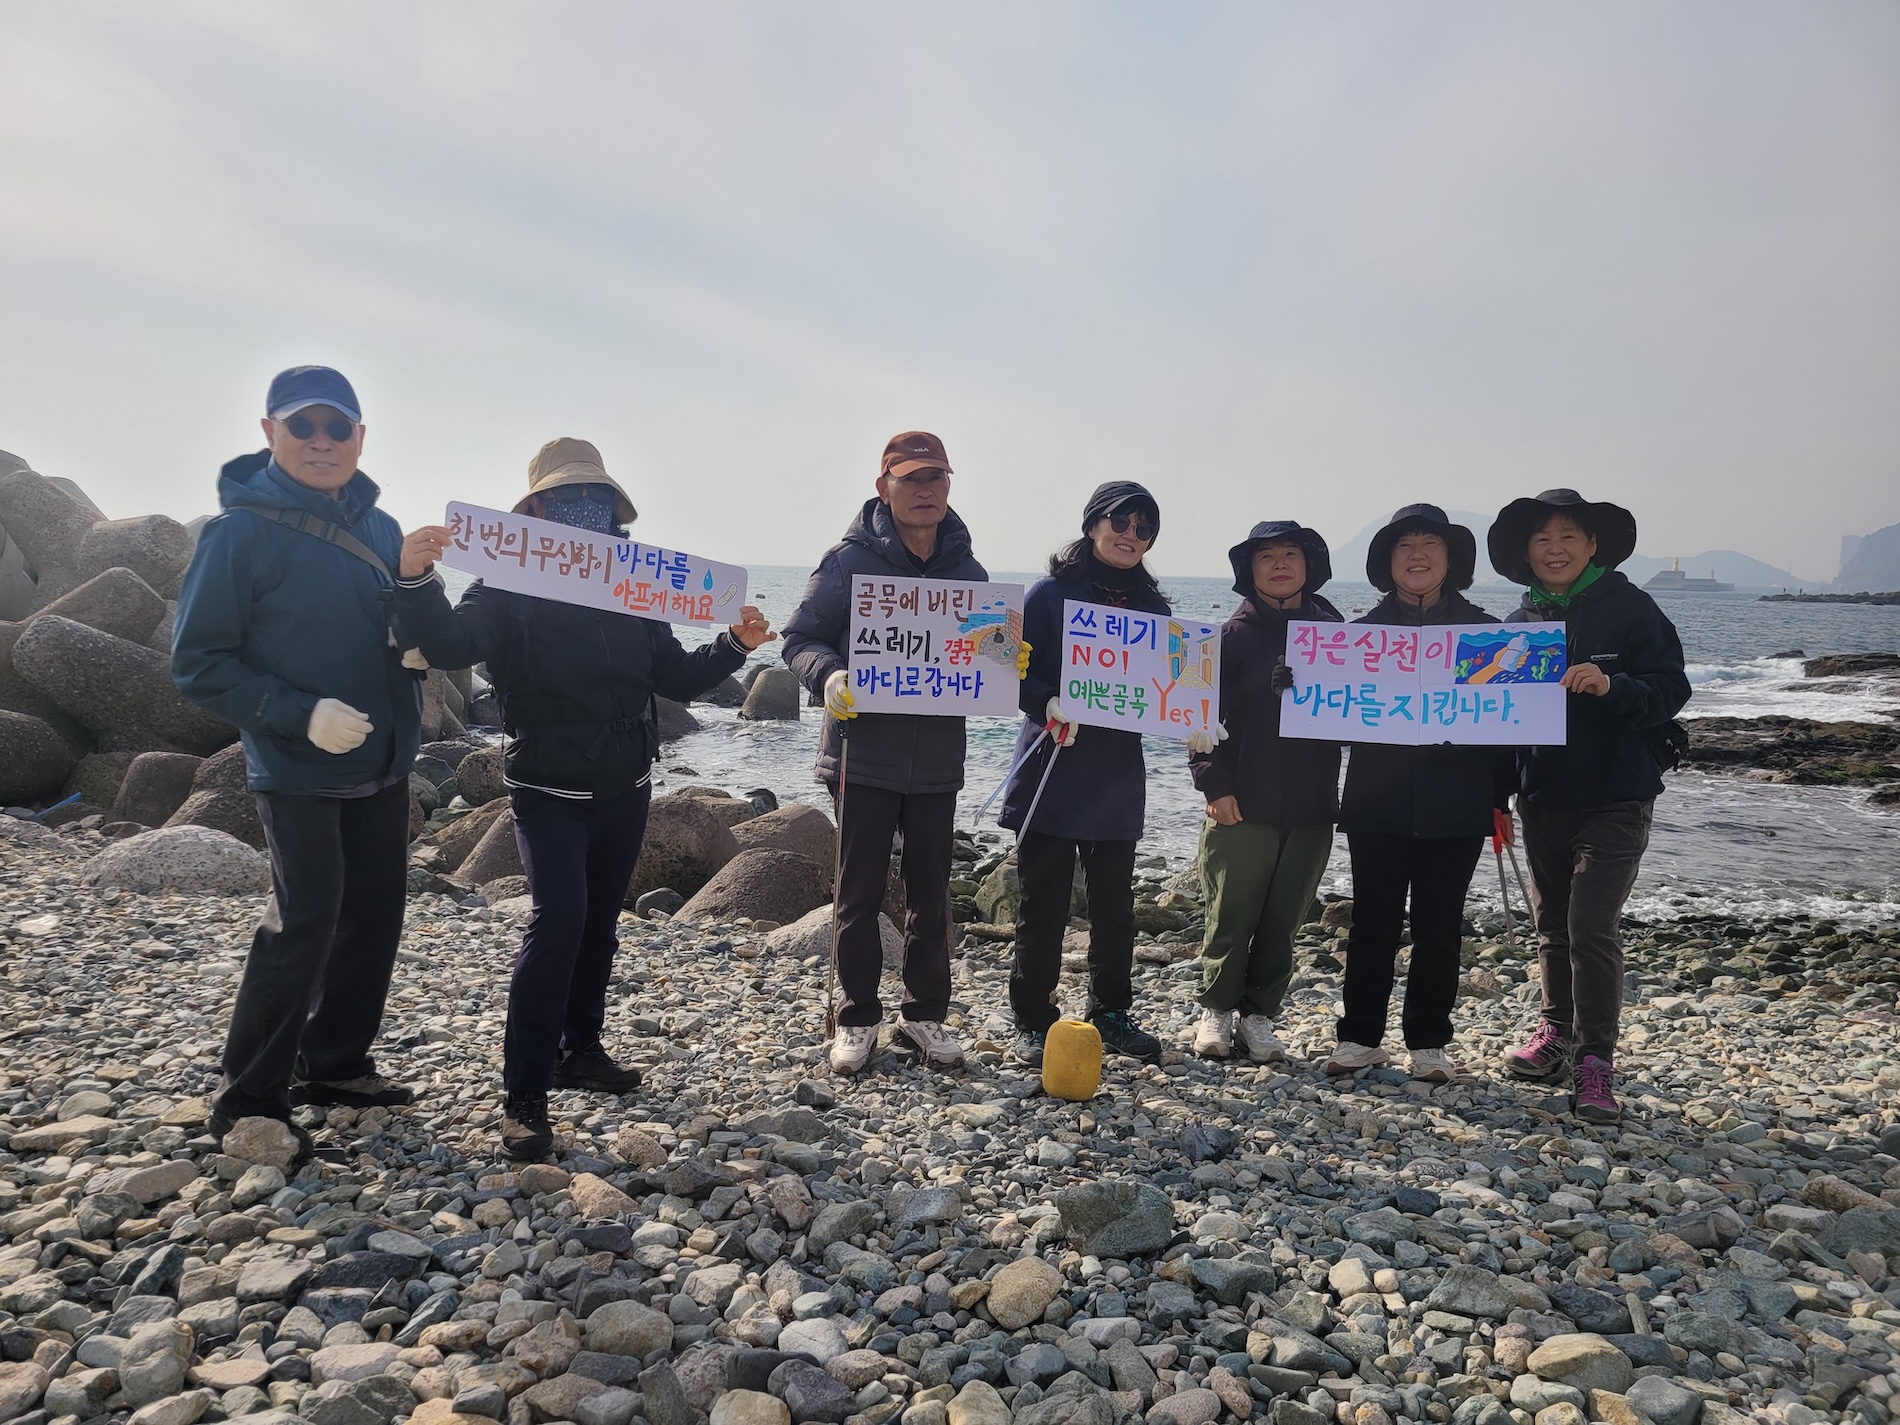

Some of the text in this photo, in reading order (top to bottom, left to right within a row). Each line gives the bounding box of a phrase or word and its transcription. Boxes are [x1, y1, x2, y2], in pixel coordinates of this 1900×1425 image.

[449, 511, 474, 551] 한
[616, 543, 692, 591] 바다를
[857, 582, 974, 623] 골목에 버린
[854, 626, 976, 667] 쓰레기, 결국
[1069, 607, 1157, 651] 쓰레기
[1293, 625, 1349, 666] 작은
[1072, 644, 1129, 676] NO!
[1151, 676, 1210, 731] Yes!
